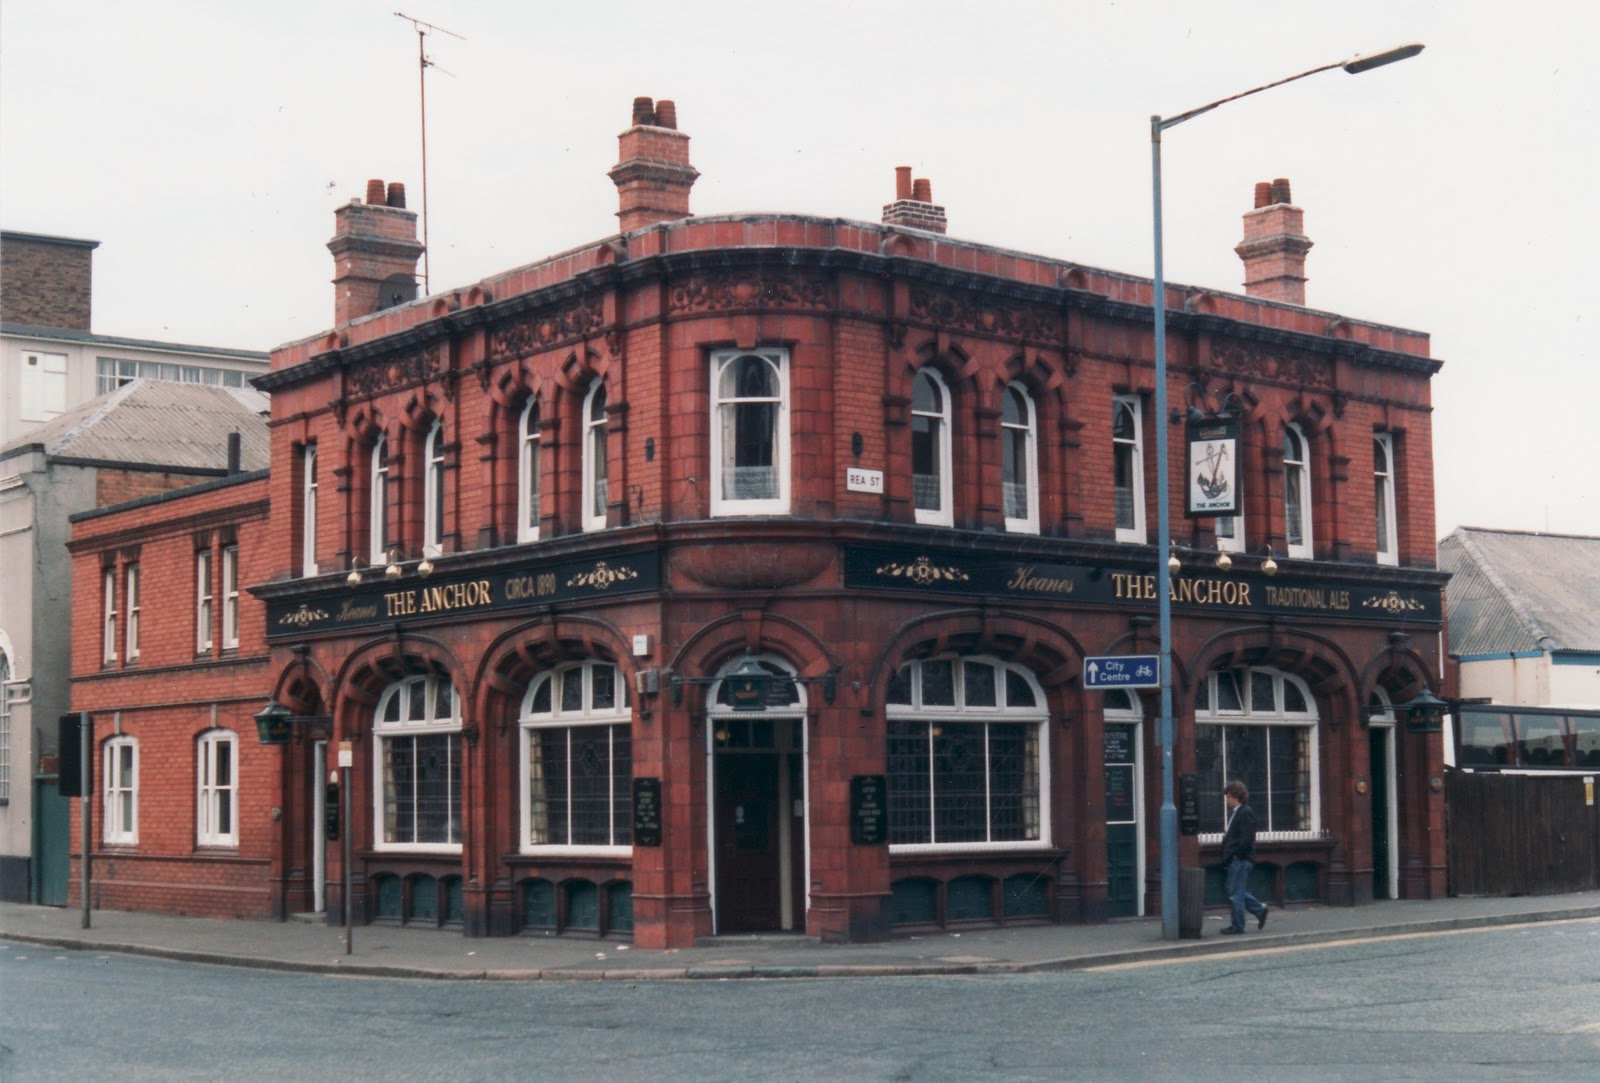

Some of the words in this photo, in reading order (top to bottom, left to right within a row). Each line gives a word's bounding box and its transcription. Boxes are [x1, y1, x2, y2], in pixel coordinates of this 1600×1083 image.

[850, 474, 866, 485] REA
[870, 476, 880, 486] ST
[1007, 566, 1074, 593] Keanes
[1111, 573, 1157, 600] THE
[1168, 577, 1252, 606] ANCHOR
[1264, 585, 1327, 609] TRADITIONAL
[1329, 590, 1350, 610] ALES
[384, 590, 417, 617] THE
[420, 580, 492, 612] ANCHOR
[505, 576, 535, 600] CIRCA
[537, 573, 556, 597] 1890
[1105, 661, 1125, 671] City
[1100, 672, 1131, 682] Centre
